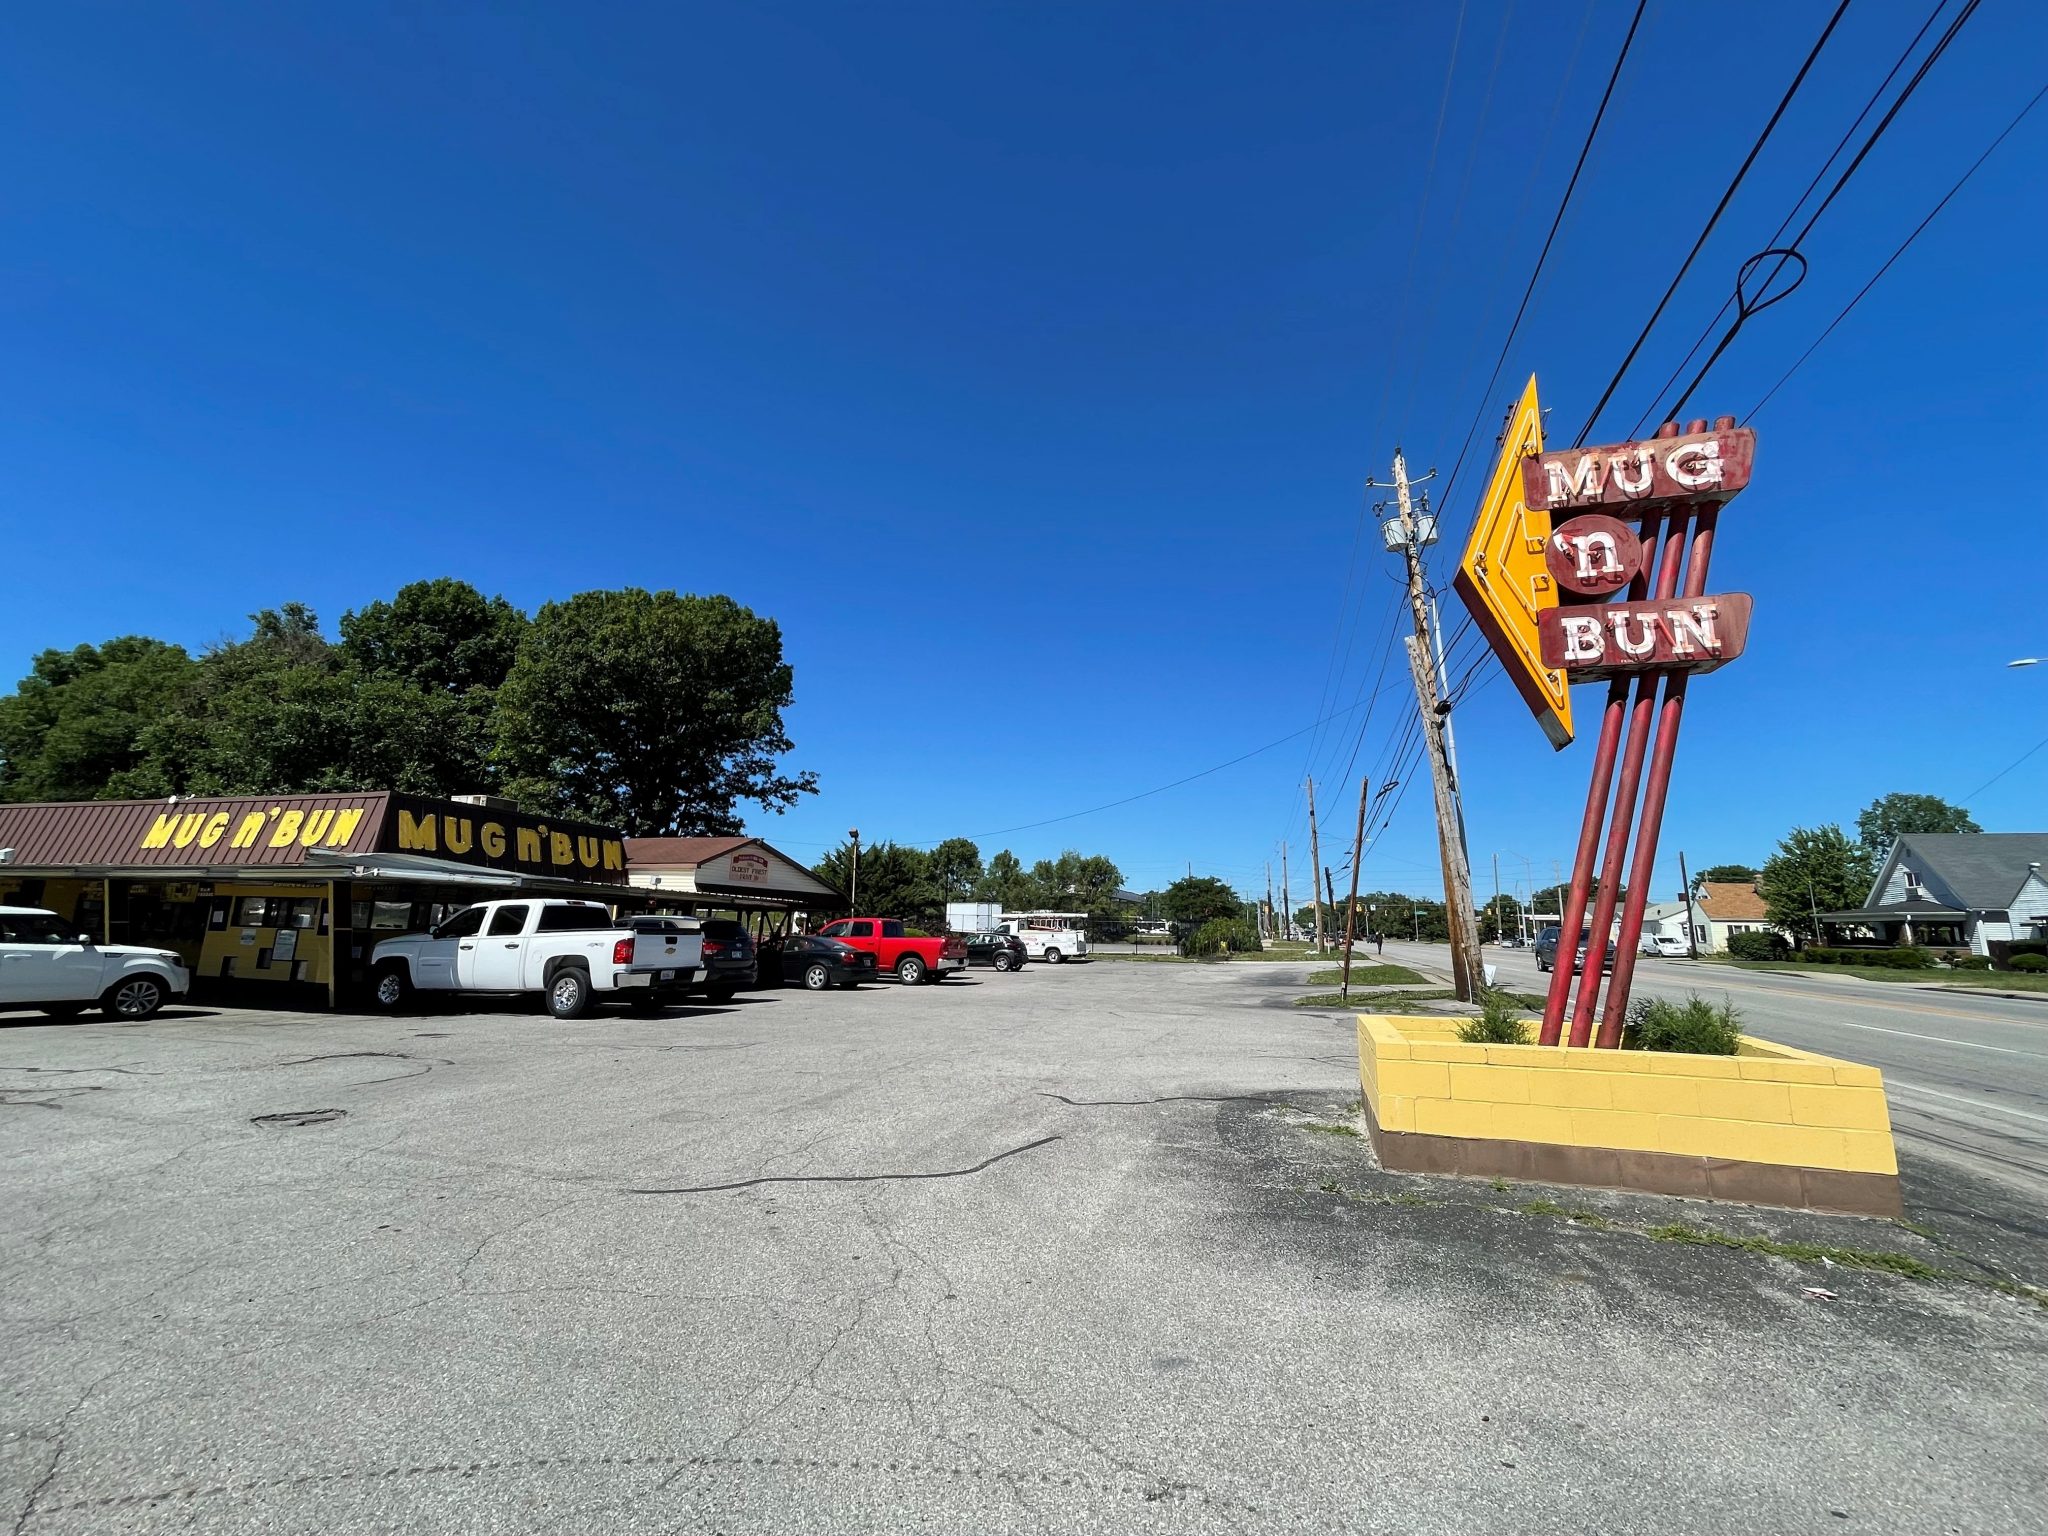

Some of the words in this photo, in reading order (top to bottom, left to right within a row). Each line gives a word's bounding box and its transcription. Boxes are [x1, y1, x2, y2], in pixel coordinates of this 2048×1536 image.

[1543, 440, 1724, 503] MUG
[1560, 602, 1722, 661] BUN
[141, 811, 230, 850] MUG
[398, 809, 507, 859] MUG
